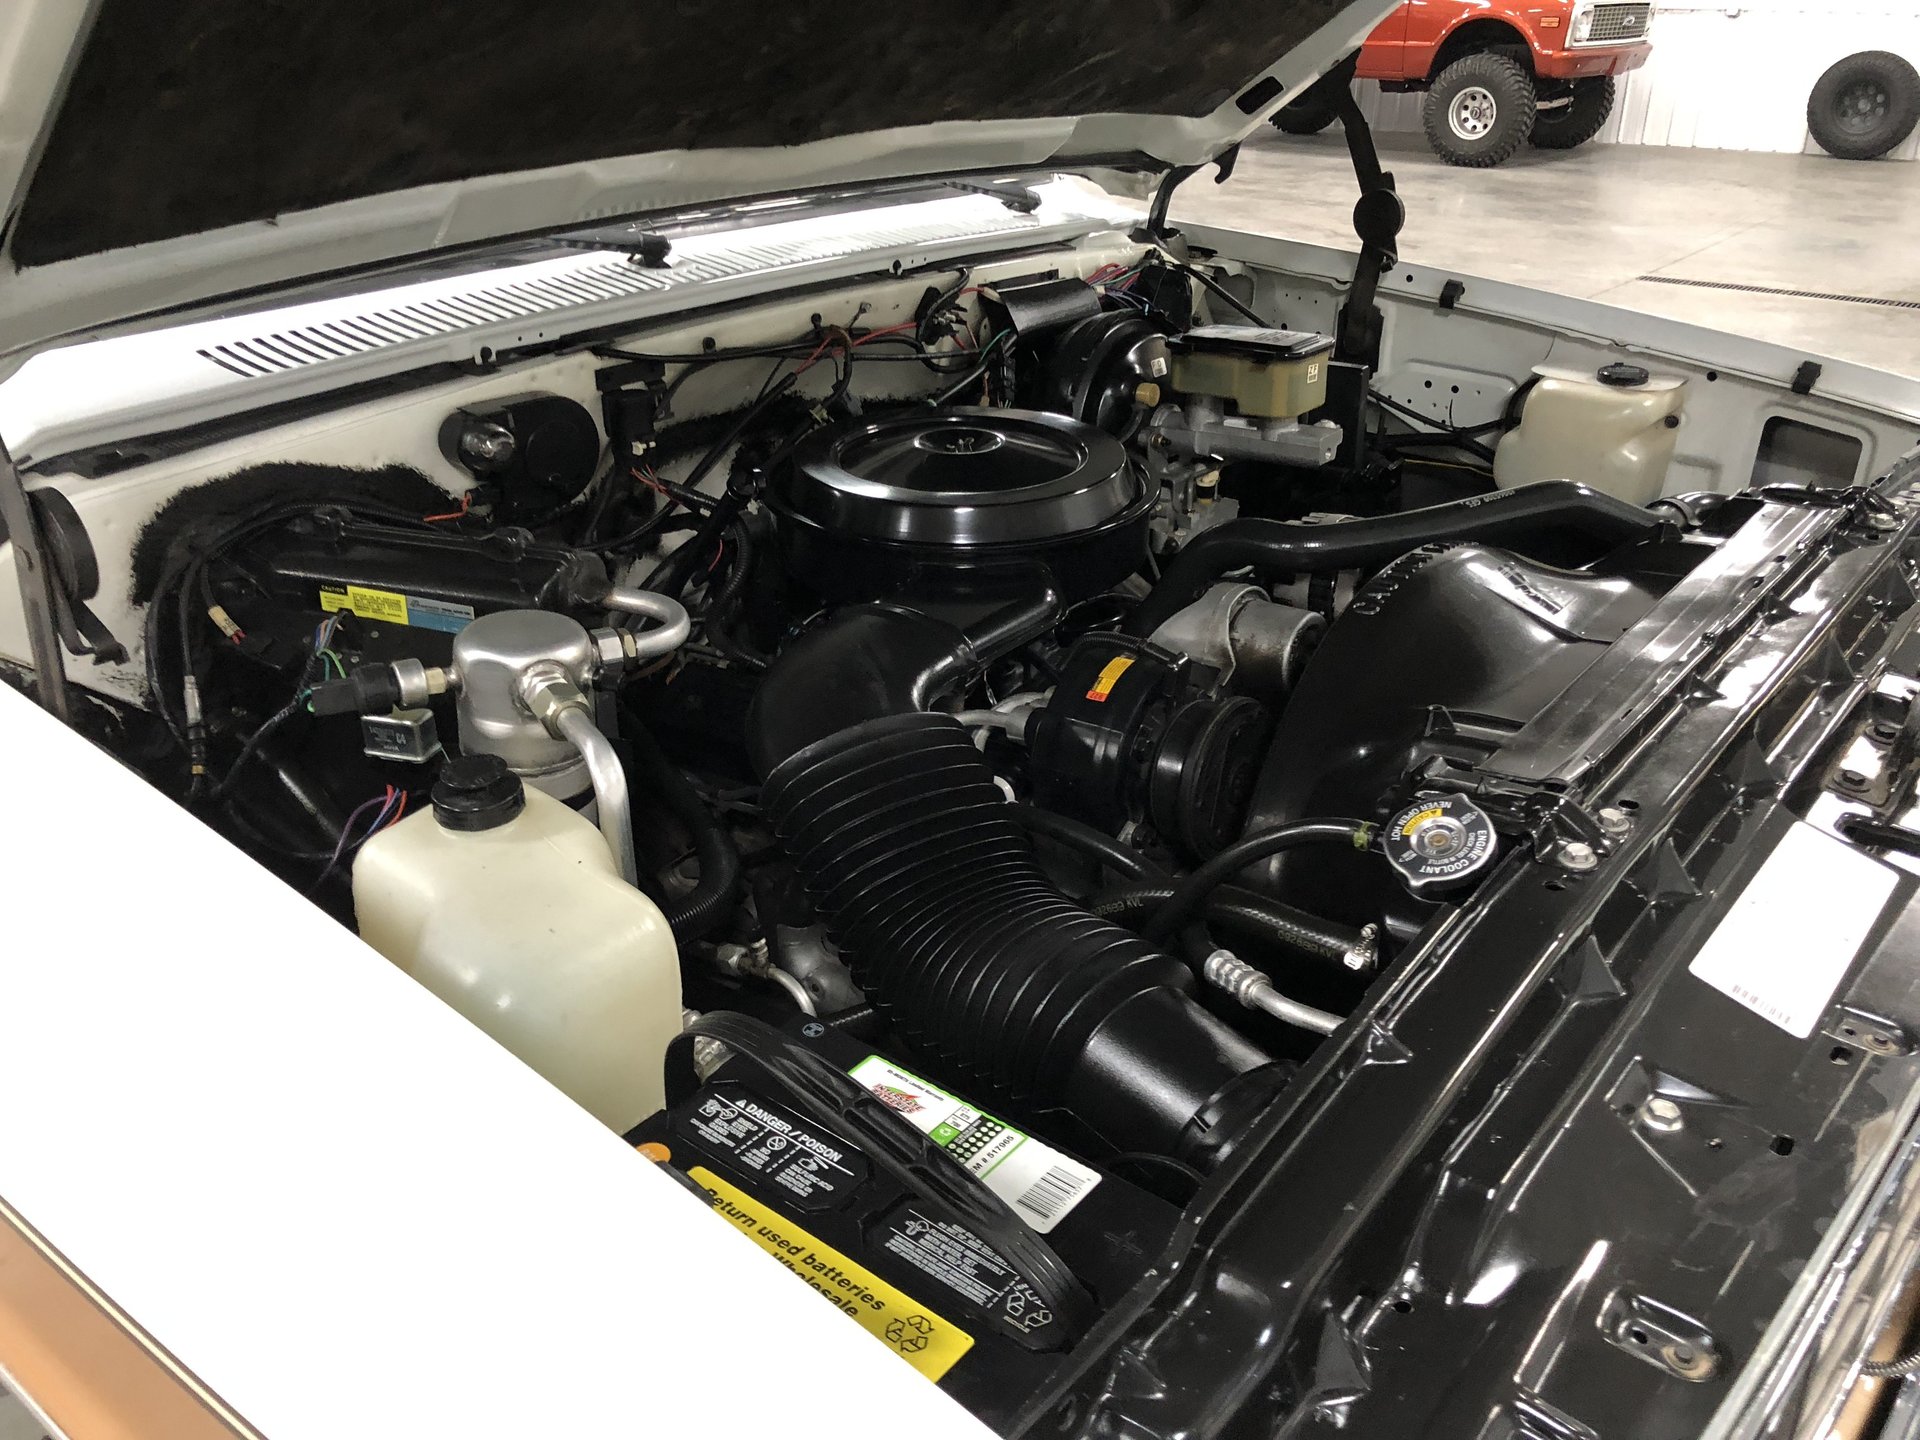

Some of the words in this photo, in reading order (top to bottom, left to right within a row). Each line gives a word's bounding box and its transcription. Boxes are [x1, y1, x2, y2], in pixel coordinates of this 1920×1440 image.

[1419, 801, 1453, 812] NEVER
[1400, 807, 1420, 827] OPEN
[1391, 828, 1404, 842] HOT
[1467, 830, 1487, 860] ENGINE
[1419, 859, 1470, 874] COOLANT
[713, 1118, 746, 1138] EXPLOSIVE
[736, 1117, 759, 1131] SHIELD
[743, 1103, 793, 1133] DANGER
[797, 1134, 843, 1162] POISON
[759, 1147, 772, 1155] NO
[789, 1164, 821, 1183] SULFURIC
[818, 1181, 835, 1191] ACID
[924, 1234, 942, 1246] WITH
[918, 1238, 946, 1257] MEDICAL
[944, 1254, 962, 1266] HELP
[960, 1263, 979, 1276] FAST
[929, 1228, 950, 1243] FLUSH
[948, 1240, 966, 1252] EYES
[963, 1249, 1006, 1276] IMMEDIATELY
[757, 1224, 806, 1257] used
[801, 1253, 886, 1311] batteries
